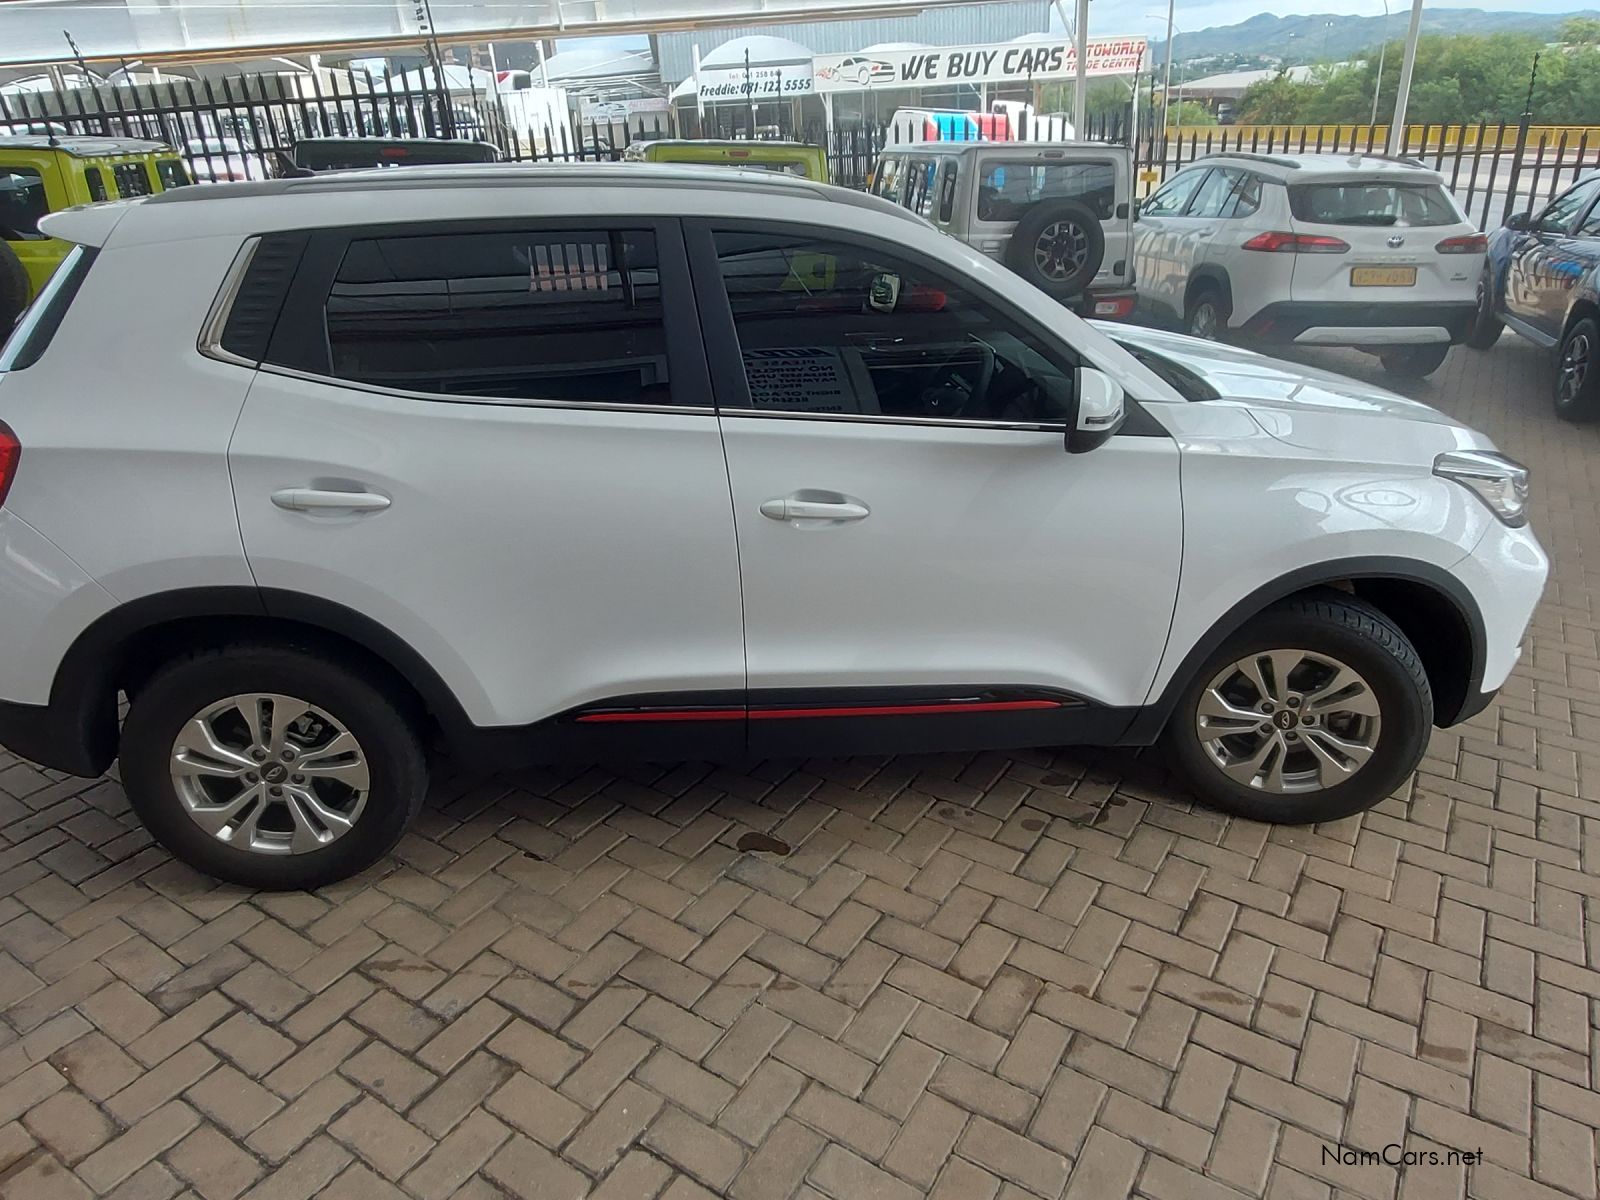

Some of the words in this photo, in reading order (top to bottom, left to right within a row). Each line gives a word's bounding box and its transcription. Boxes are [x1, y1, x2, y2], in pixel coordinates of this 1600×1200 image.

[1066, 41, 1146, 58] ATOWORLD
[901, 53, 941, 81] WE
[947, 49, 999, 78] BUY
[1003, 45, 1065, 75] CARS
[700, 83, 739, 96] Freddie:
[784, 78, 812, 91] 5555
